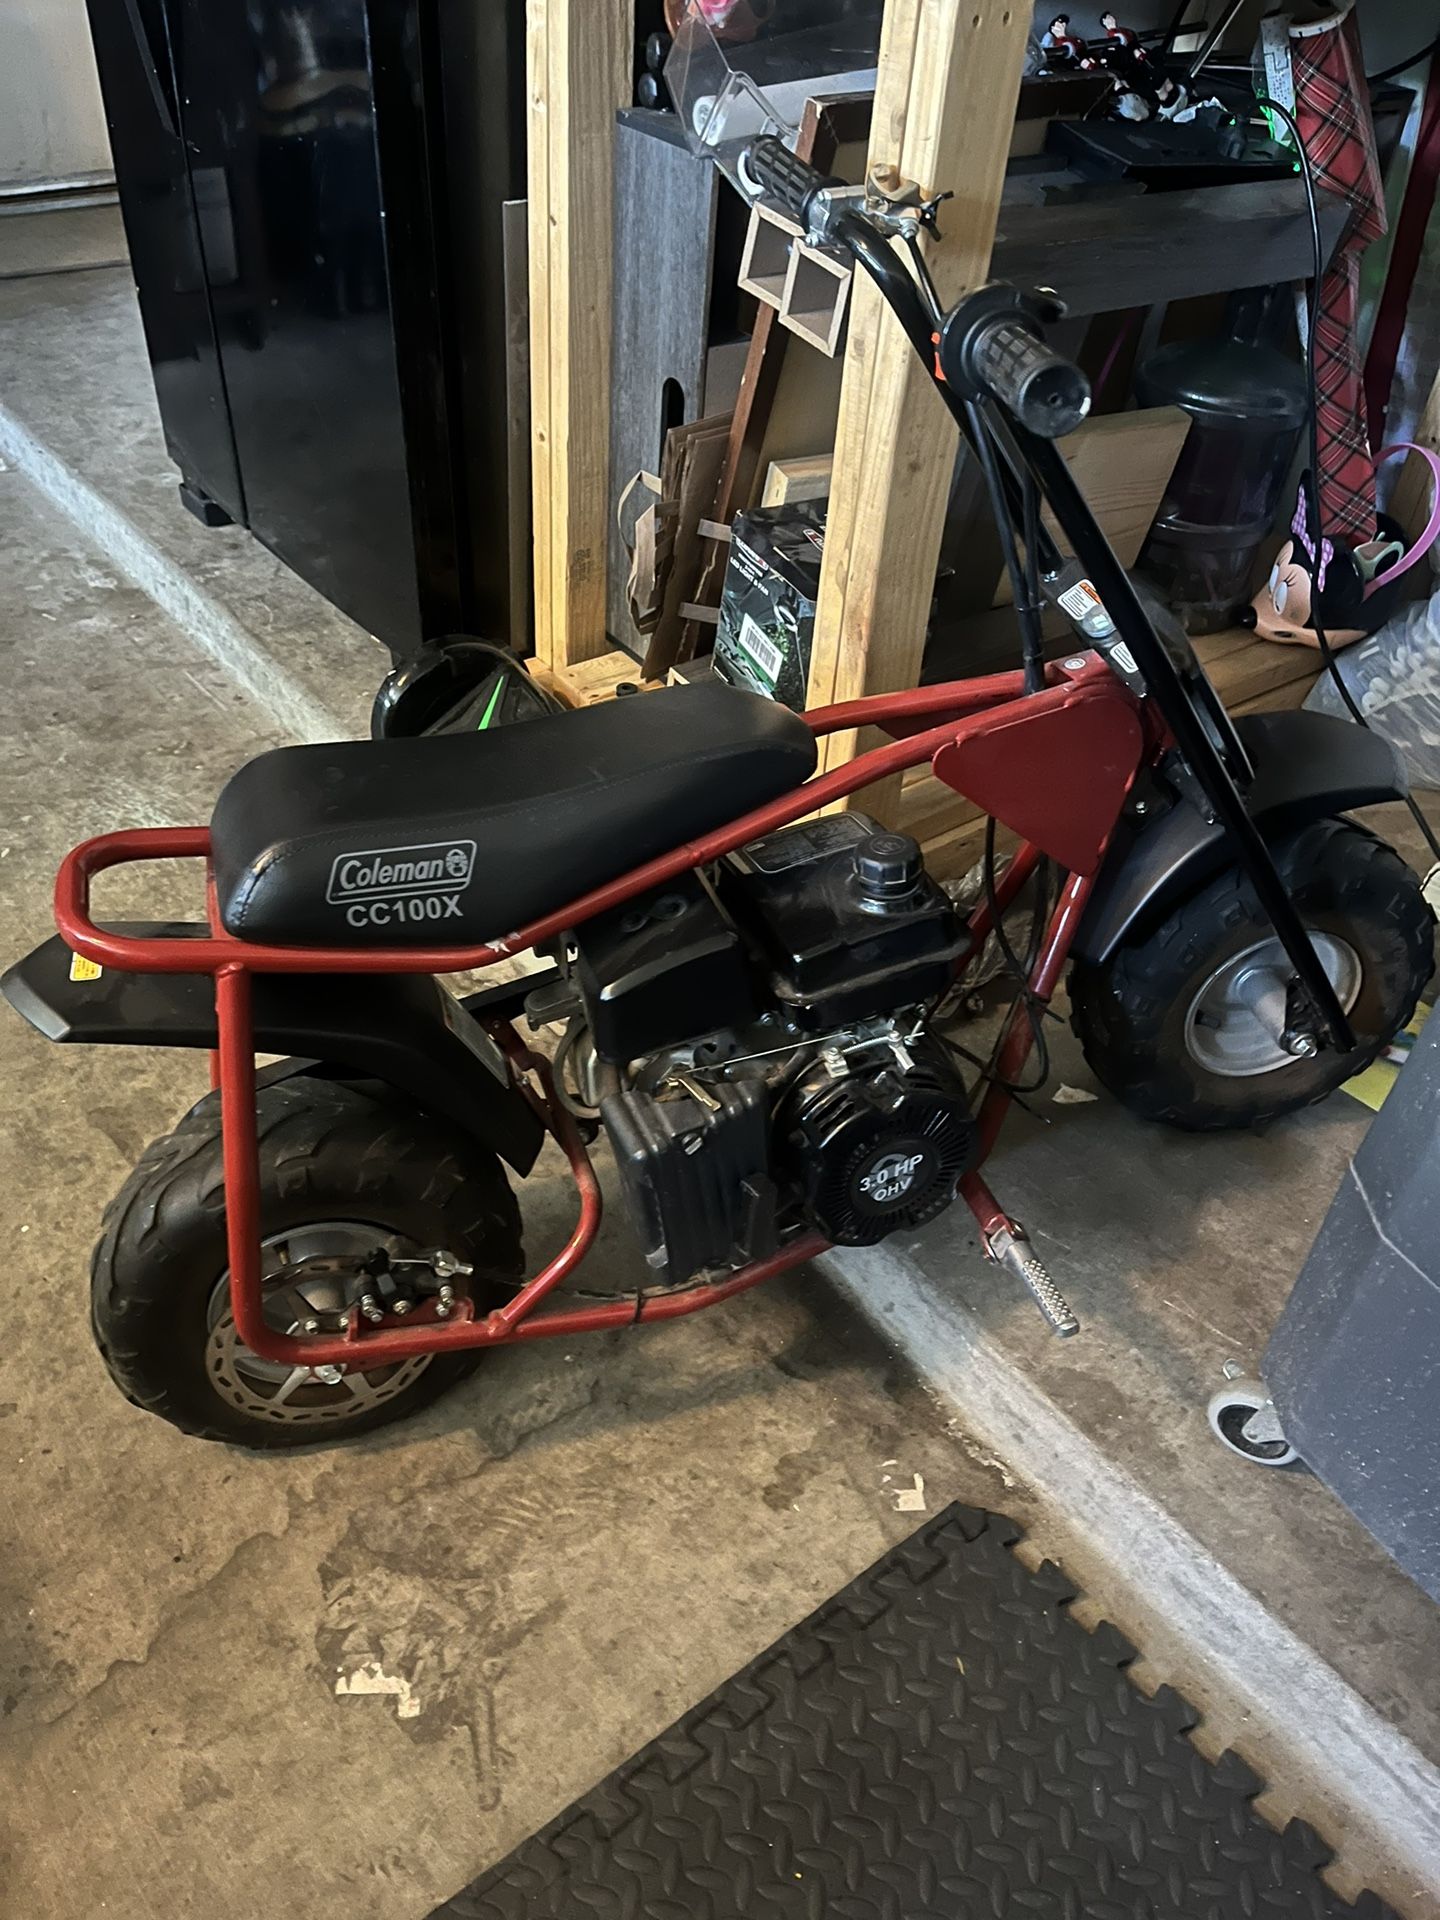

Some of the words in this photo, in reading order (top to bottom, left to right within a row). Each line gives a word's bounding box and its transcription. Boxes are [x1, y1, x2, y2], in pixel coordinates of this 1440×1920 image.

[339, 857, 444, 890] Coleman
[346, 894, 464, 928] CC100X
[859, 1170, 889, 1192] 3.0
[894, 1154, 924, 1178] HP
[873, 1176, 913, 1202] OHV
